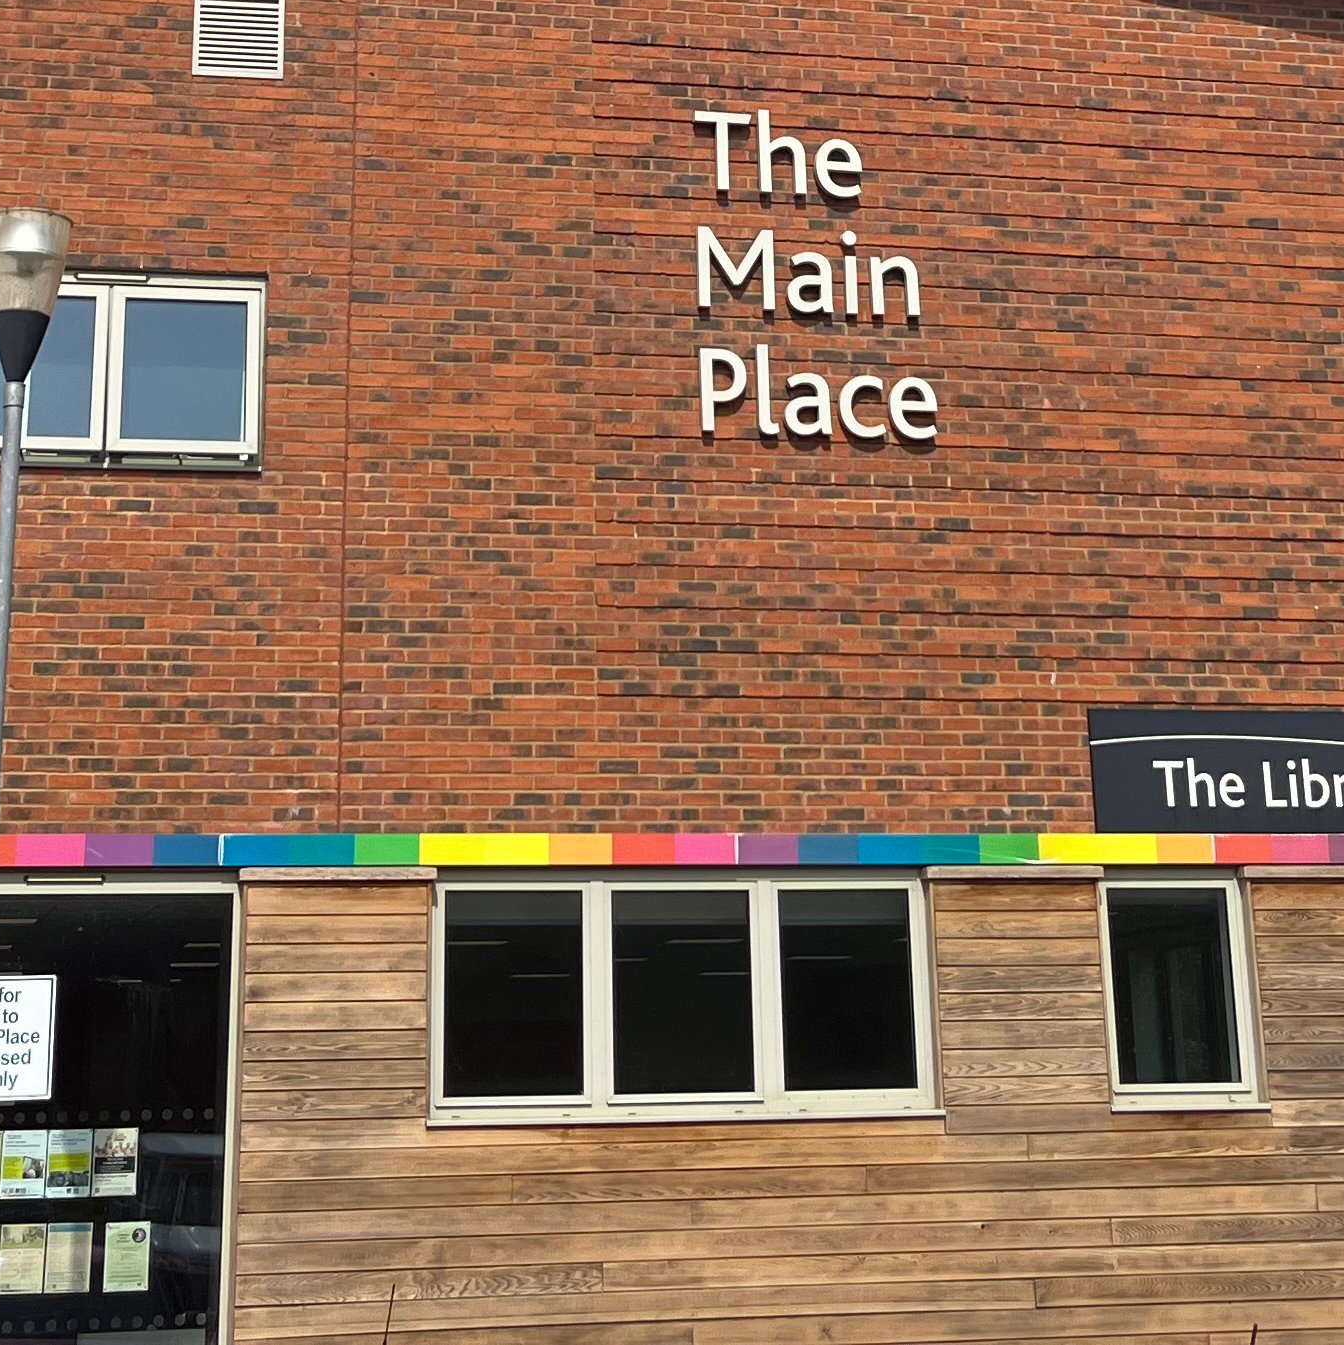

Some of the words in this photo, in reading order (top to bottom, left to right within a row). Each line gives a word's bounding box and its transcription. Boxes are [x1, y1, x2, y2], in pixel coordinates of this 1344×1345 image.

[694, 109, 863, 198] The
[697, 226, 921, 316] Main
[699, 344, 938, 439] Place
[1153, 757, 1245, 808] The
[3, 1009, 19, 1023] to
